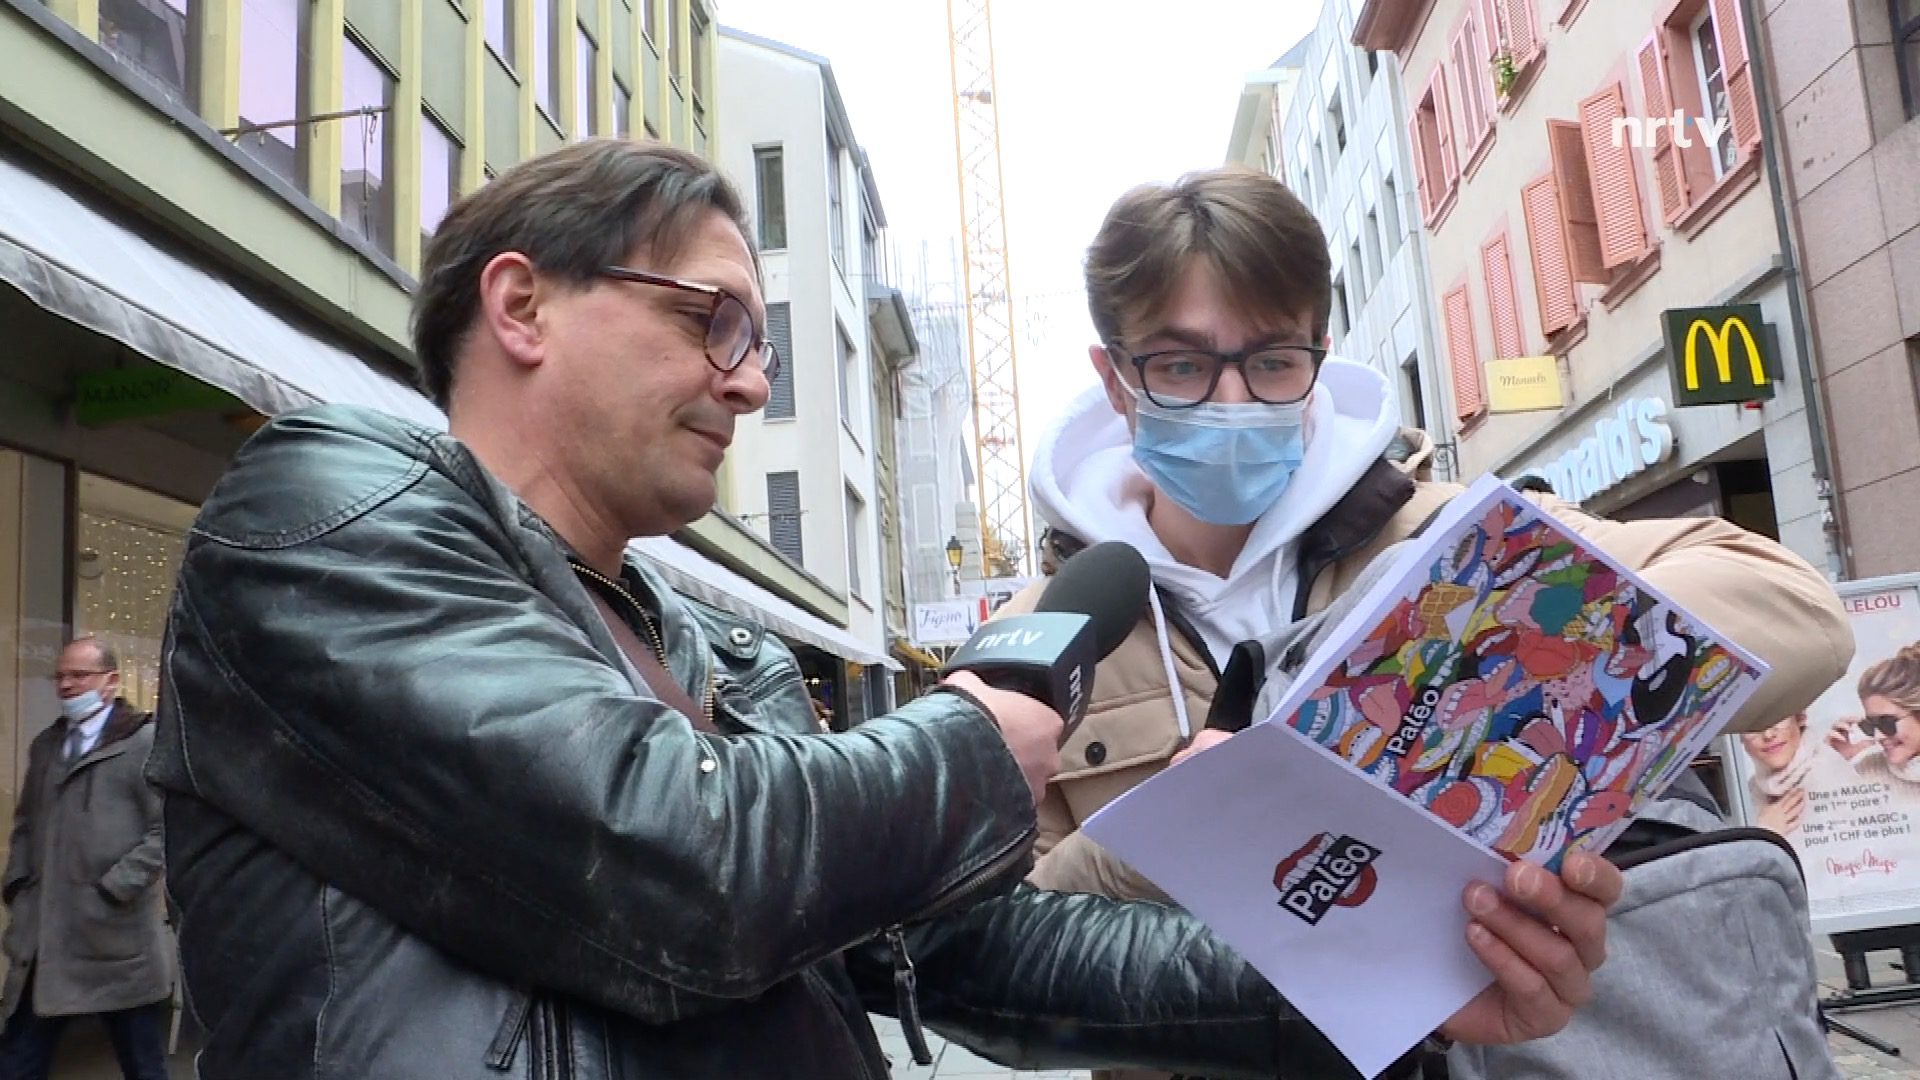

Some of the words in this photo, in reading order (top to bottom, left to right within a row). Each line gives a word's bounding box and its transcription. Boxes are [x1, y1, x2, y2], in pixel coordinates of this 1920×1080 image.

[1516, 397, 1673, 502] onald's
[1843, 594, 1900, 613] LELOU
[975, 628, 1044, 651] nrtv
[1386, 689, 1440, 755] Paléo
[1808, 791, 1830, 801] Une
[1840, 783, 1882, 796] MAGIC
[1814, 804, 1828, 812] en
[1850, 797, 1880, 811] paire
[1803, 823, 1824, 833] Une
[1857, 811, 1900, 826] MAGIC
[1804, 836, 1829, 848] pour
[1863, 829, 1878, 839] de
[1881, 825, 1904, 838] plus
[1285, 843, 1371, 919] Paléo
